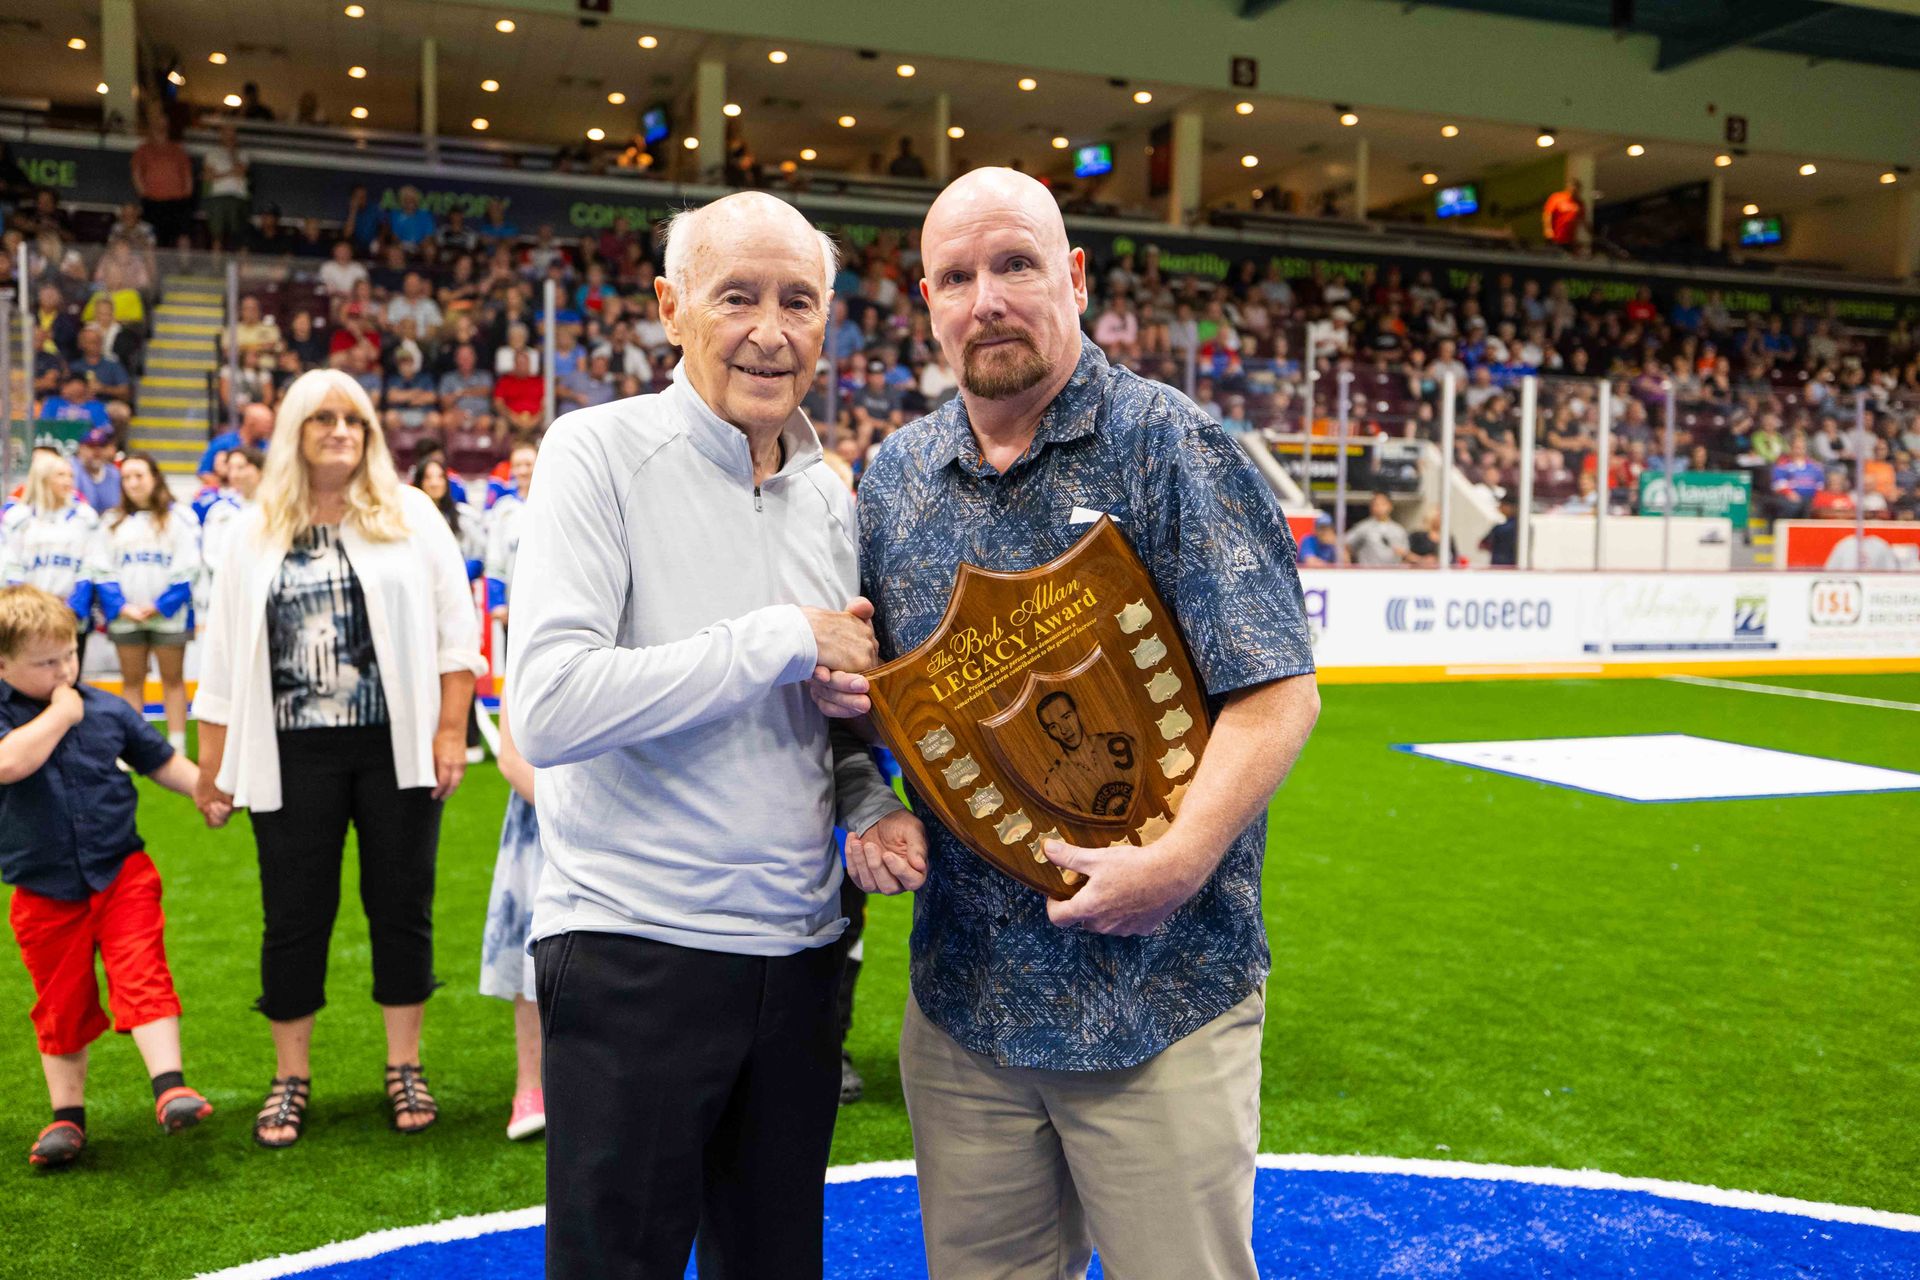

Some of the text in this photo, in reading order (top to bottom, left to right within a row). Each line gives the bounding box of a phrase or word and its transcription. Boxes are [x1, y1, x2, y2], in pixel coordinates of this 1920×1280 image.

[926, 578, 1081, 675] The Bob Allan
[929, 588, 1098, 702] LEGACY Award
[1107, 736, 1134, 770] 9
